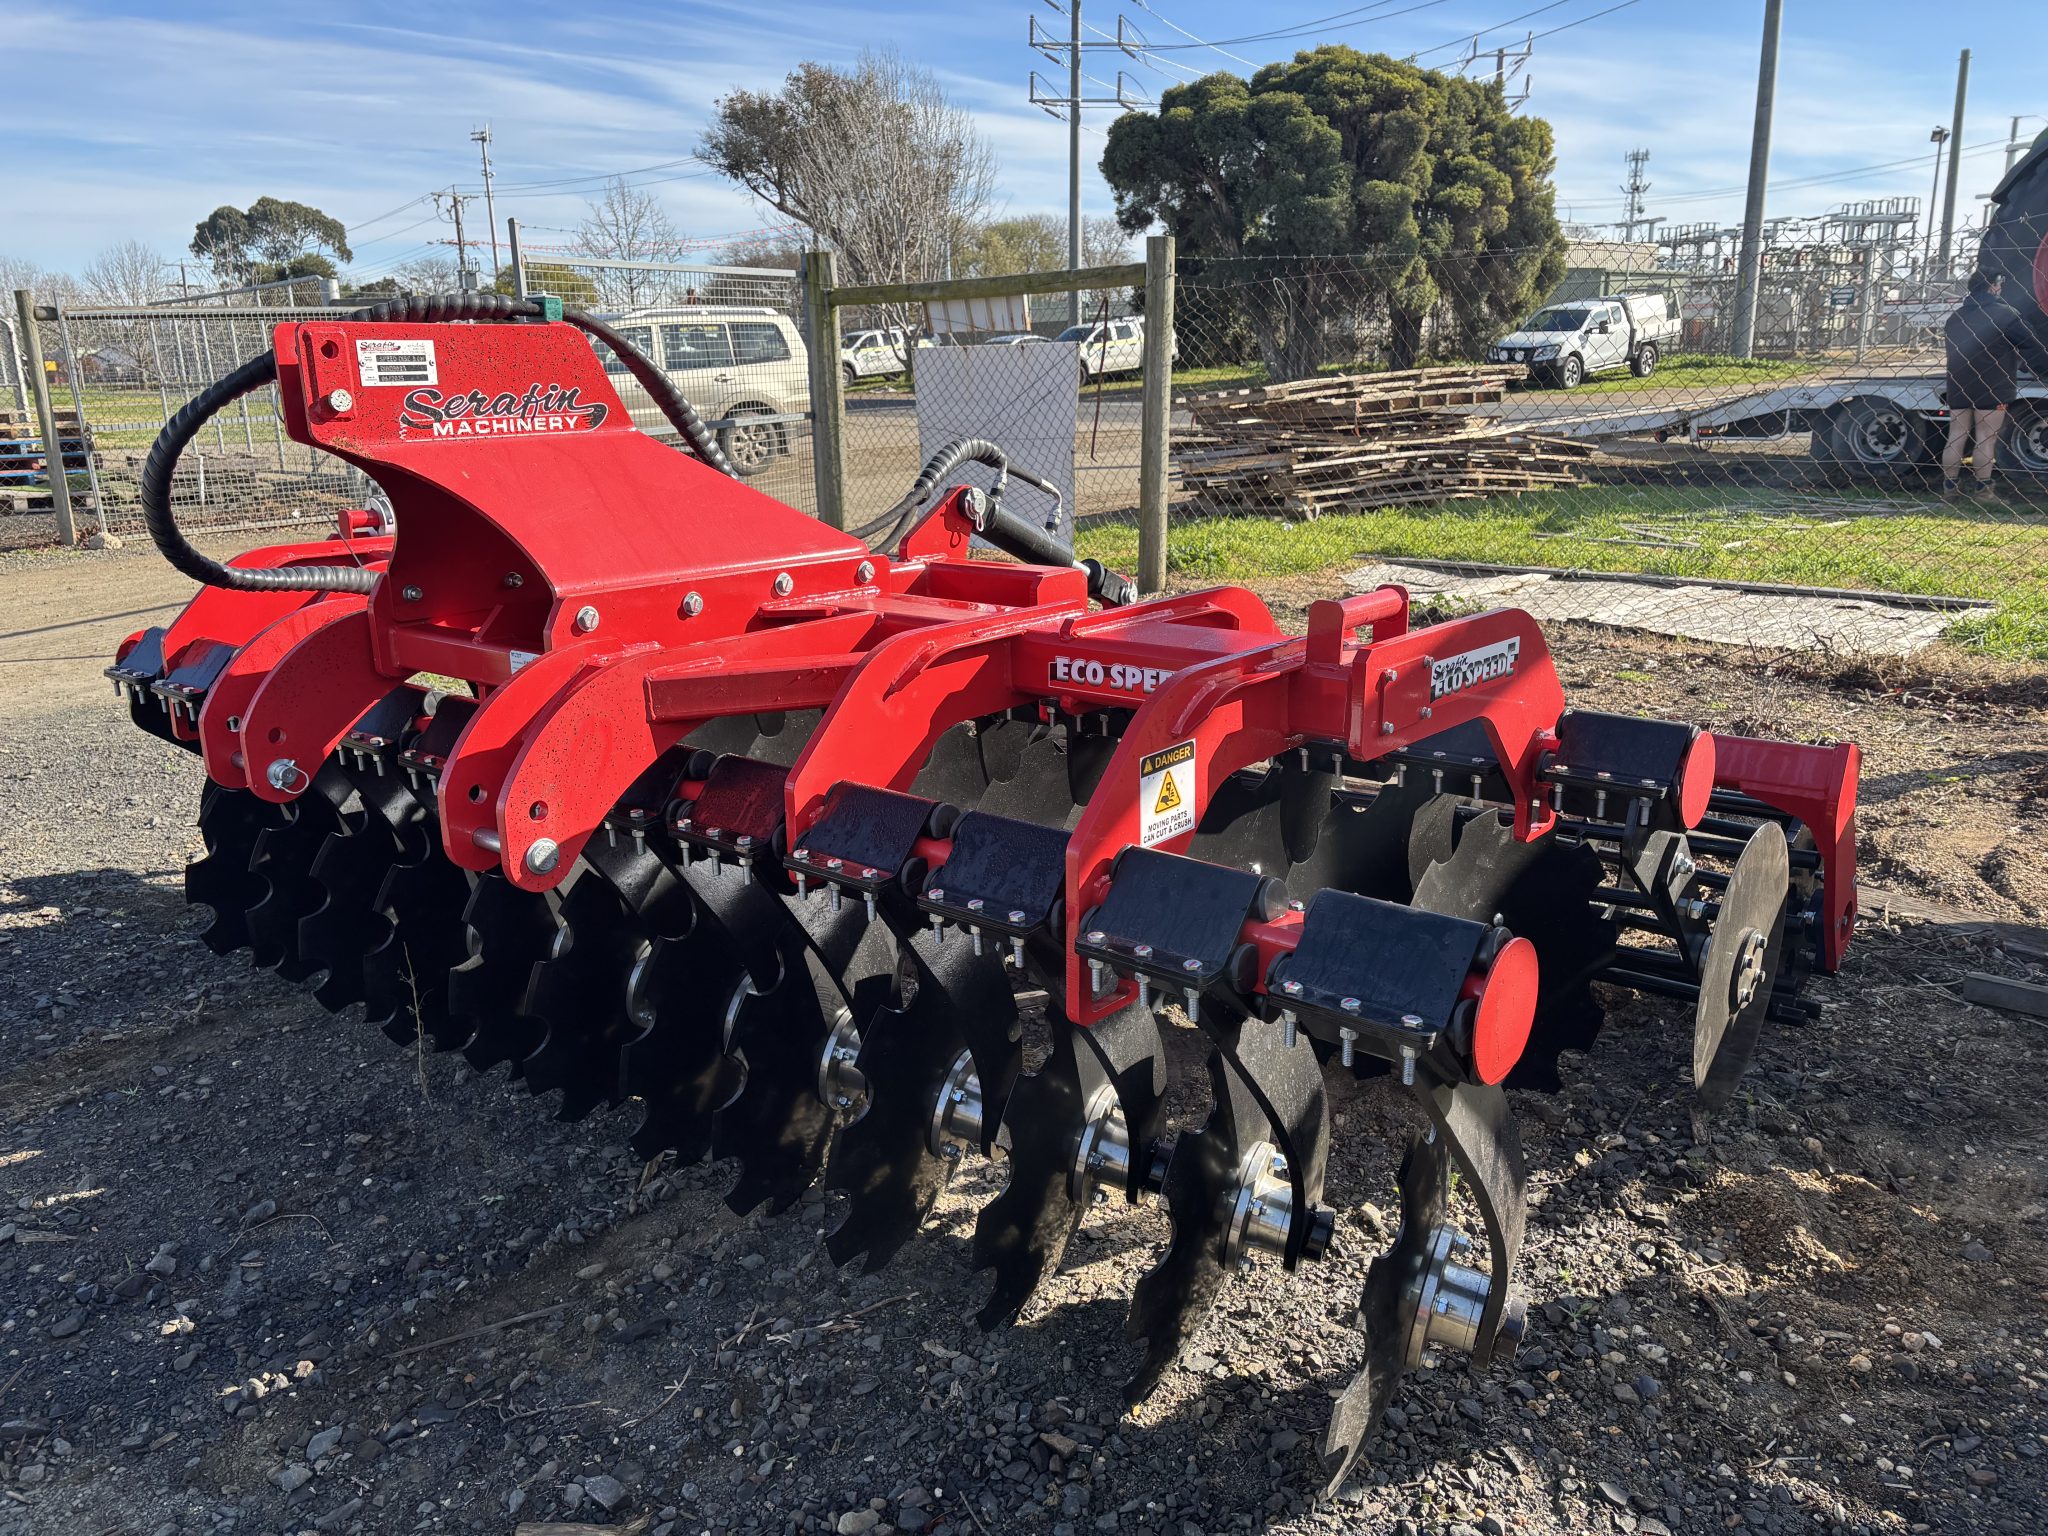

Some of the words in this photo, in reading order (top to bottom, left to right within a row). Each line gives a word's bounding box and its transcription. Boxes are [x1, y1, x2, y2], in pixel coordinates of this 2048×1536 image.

[400, 383, 607, 430] Serafin
[432, 415, 578, 437] MACHINERY
[1055, 655, 1105, 687] ECO
[1434, 666, 1463, 699] ECO
[1155, 745, 1191, 769] DANGER
[1143, 832, 1155, 844] CAN
[1156, 827, 1168, 839] CUT
[1168, 825, 1173, 833] &
[1174, 817, 1192, 831] CRUSH
[1147, 817, 1170, 833] MOVING
[1171, 810, 1188, 822] PARTS
